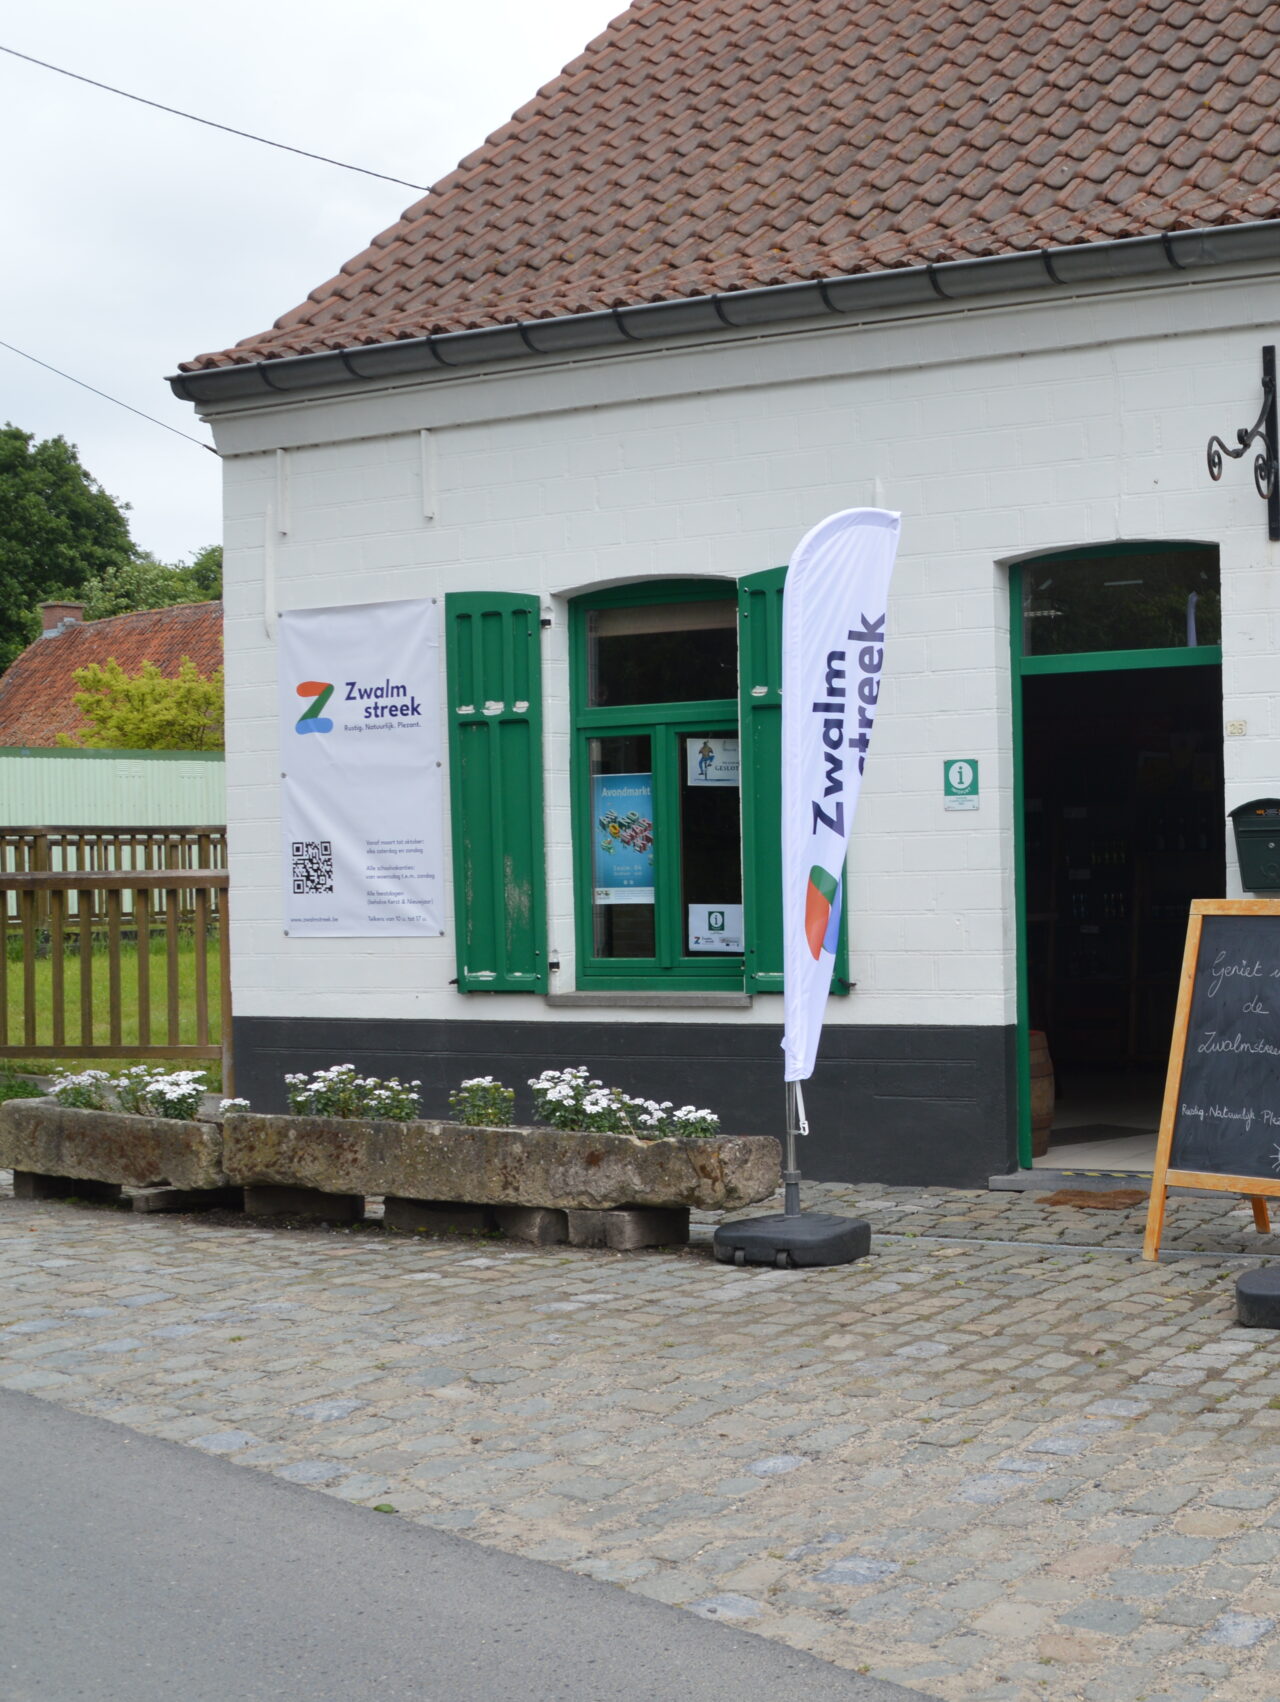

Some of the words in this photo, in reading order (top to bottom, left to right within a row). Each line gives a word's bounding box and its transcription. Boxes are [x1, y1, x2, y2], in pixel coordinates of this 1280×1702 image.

[345, 679, 407, 701] Zwalm
[364, 696, 422, 719] streek
[812, 650, 846, 838] Zwalm
[602, 787, 651, 797] Avondmarkt
[1207, 950, 1263, 998] Geniet
[1242, 994, 1270, 1014] de
